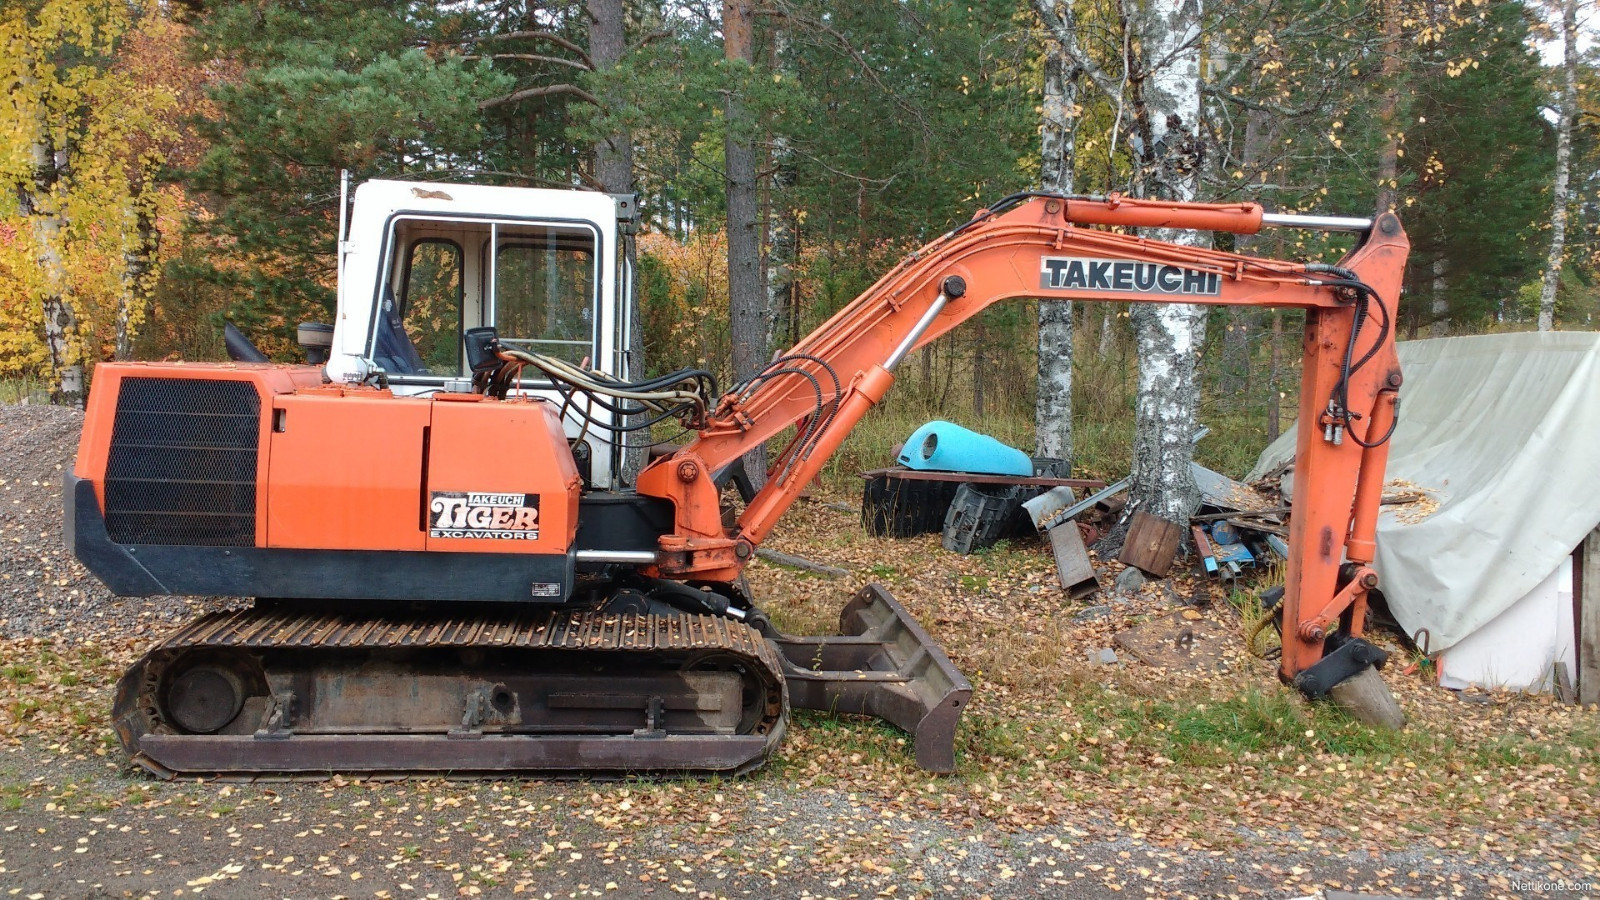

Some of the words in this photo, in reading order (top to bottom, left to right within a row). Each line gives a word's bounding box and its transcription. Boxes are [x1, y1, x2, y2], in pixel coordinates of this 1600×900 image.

[1046, 259, 1218, 294] TAKEUCHI
[467, 493, 524, 505] TAKEUCHI
[430, 497, 539, 530] TIGER
[430, 531, 538, 540] EXCAVATORS
